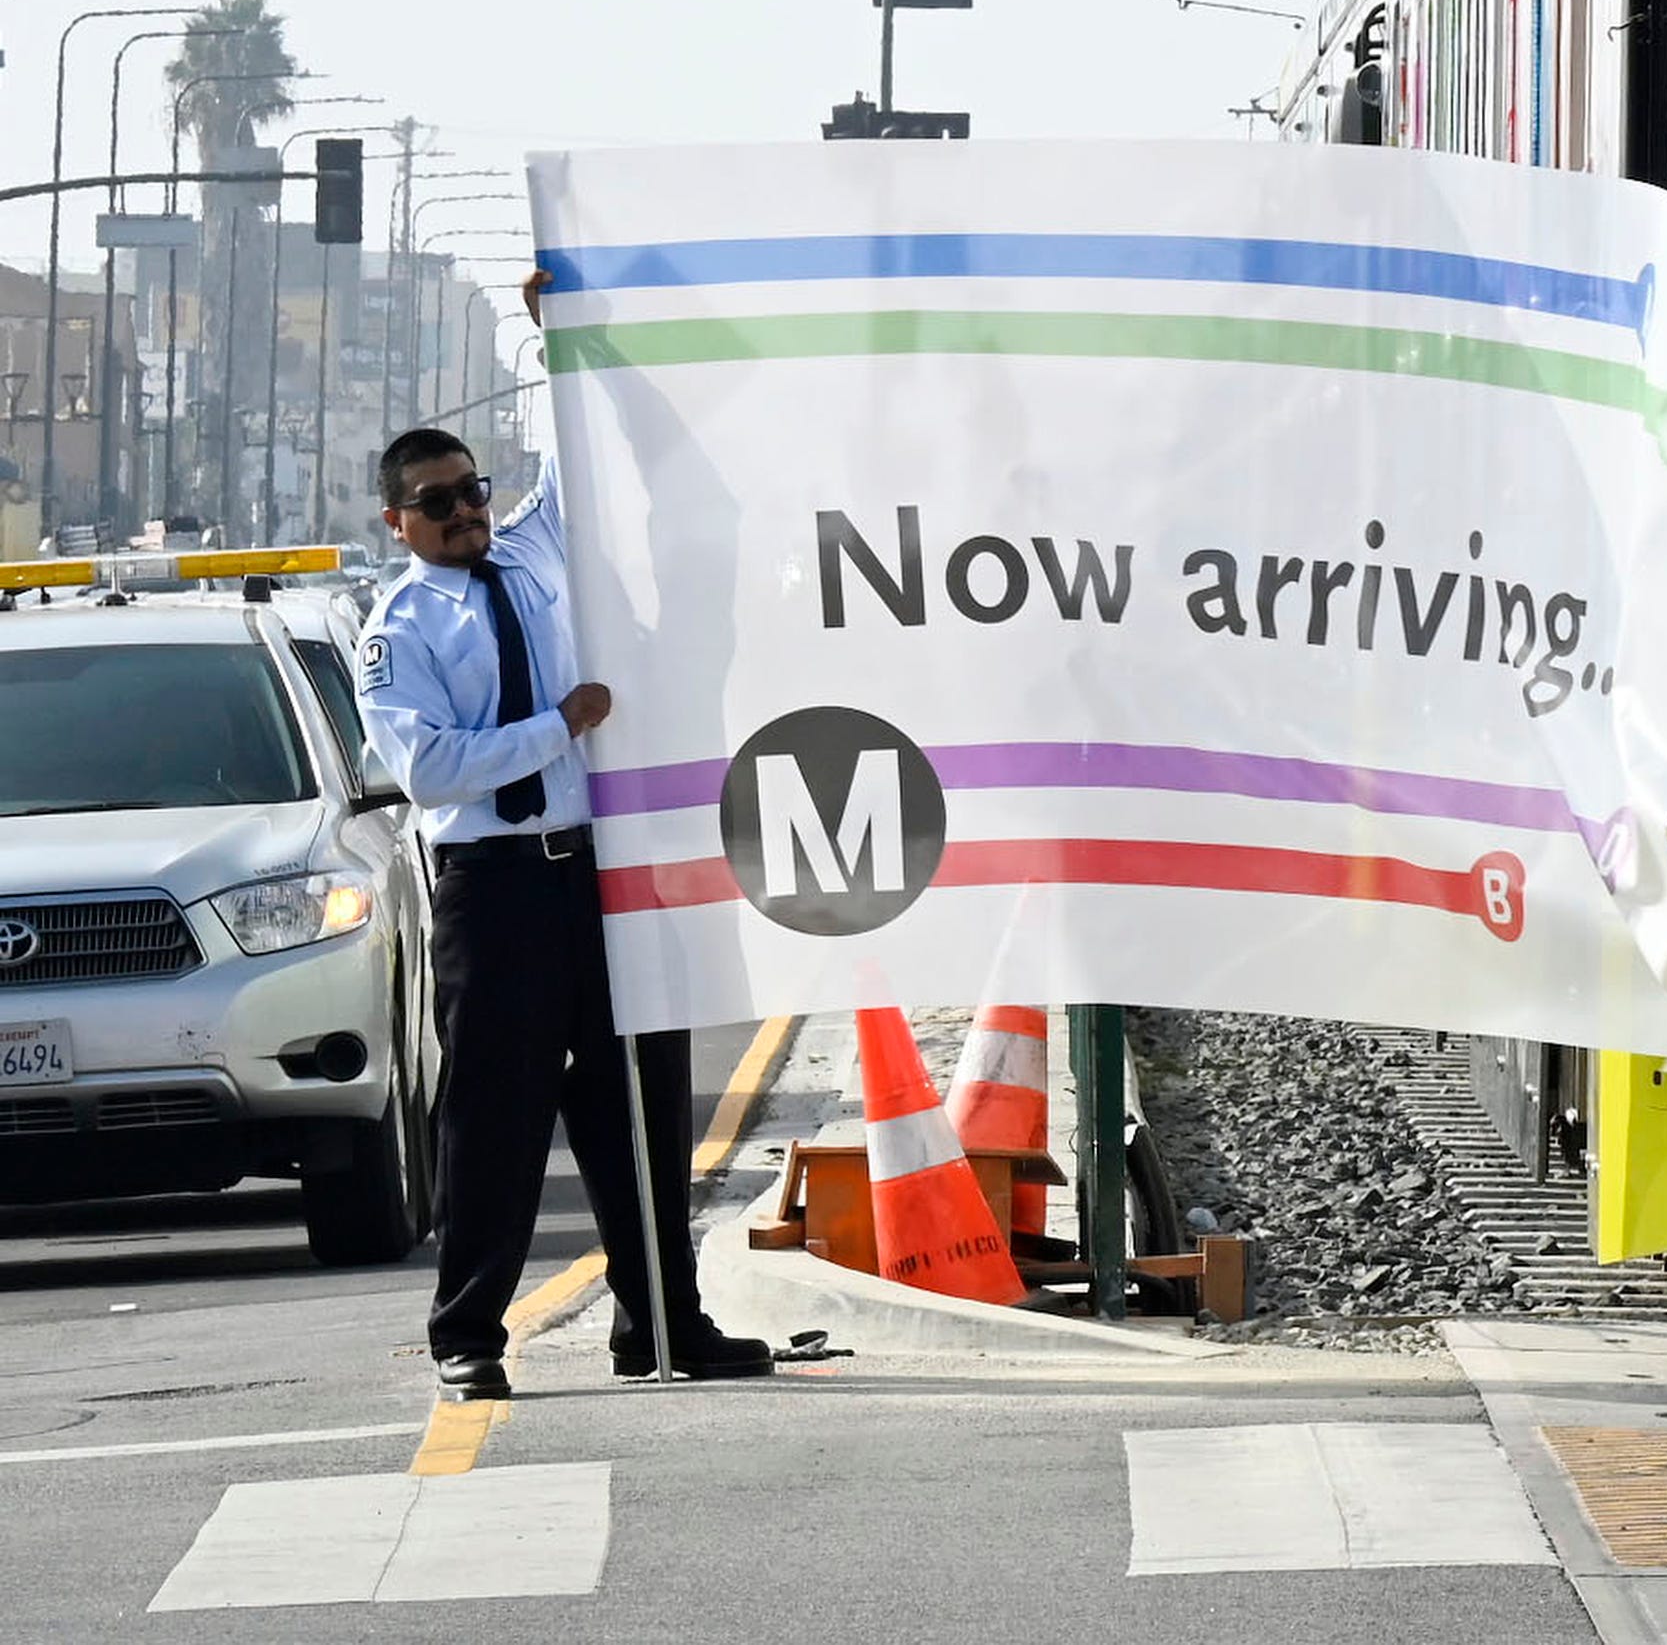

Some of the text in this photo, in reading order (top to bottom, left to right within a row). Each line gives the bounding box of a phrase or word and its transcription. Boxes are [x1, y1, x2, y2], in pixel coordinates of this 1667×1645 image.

[815, 504, 1135, 629] Now
[755, 748, 904, 897] M
[1482, 867, 1514, 925] B
[0, 1043, 63, 1075] 6494
